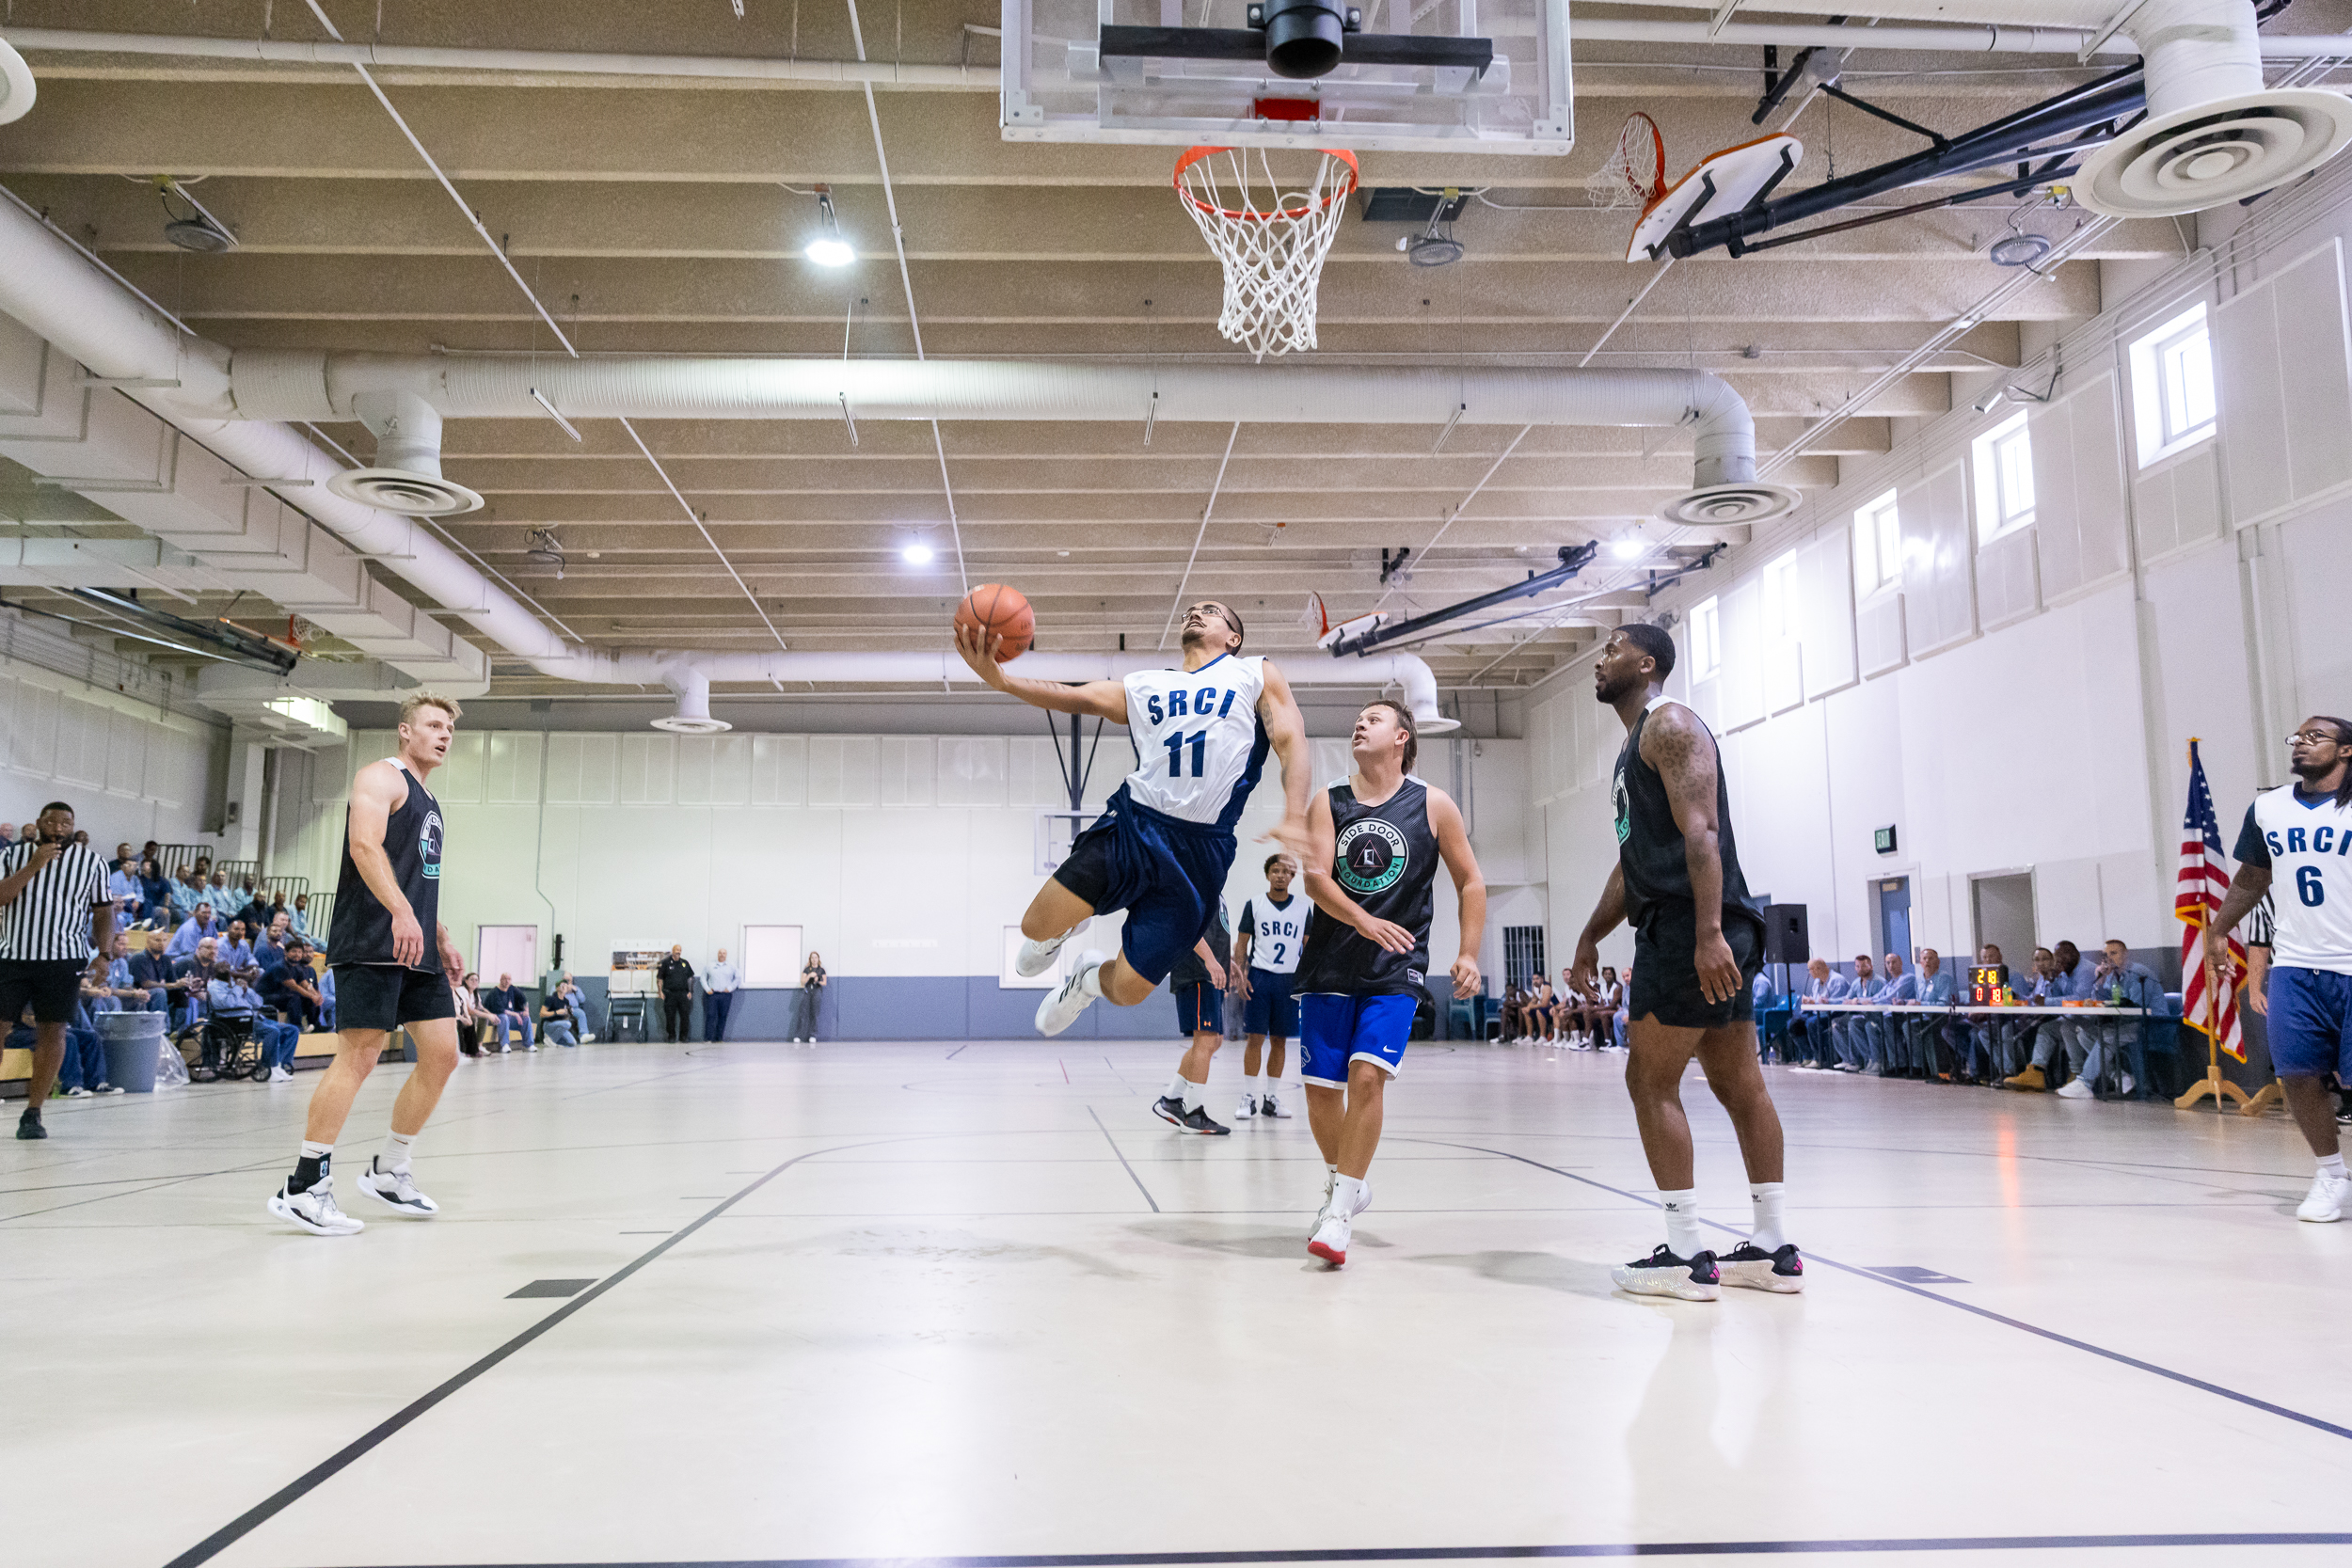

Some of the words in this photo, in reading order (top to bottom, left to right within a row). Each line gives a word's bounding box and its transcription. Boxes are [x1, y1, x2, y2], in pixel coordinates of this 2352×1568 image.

[1148, 688, 1236, 725] SRCI
[1164, 730, 1207, 777] 11
[1341, 824, 1364, 847] SIDE
[1368, 823, 1400, 847] DOOR
[2266, 826, 2352, 857] SRCI
[1341, 863, 1401, 888] FOUNDATION
[2296, 865, 2325, 908] 6
[1261, 921, 1298, 939] SRCI
[1273, 942, 1286, 965] 2
